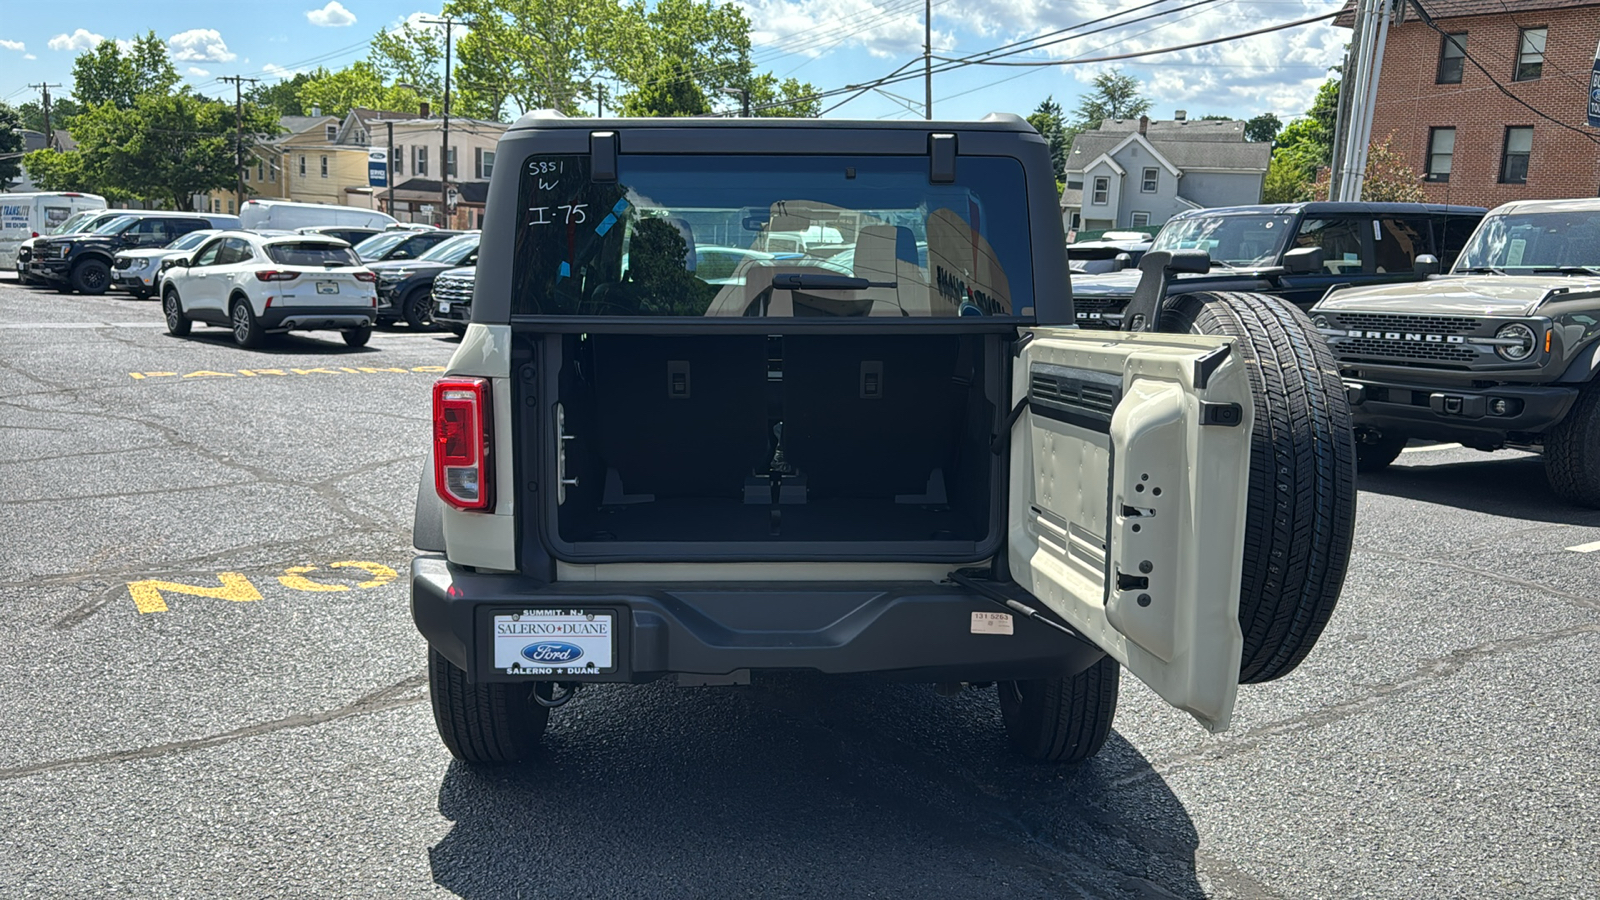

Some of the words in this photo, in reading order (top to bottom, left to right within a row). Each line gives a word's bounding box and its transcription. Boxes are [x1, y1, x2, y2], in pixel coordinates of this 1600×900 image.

[1348, 330, 1464, 344] BRONCO
[126, 560, 398, 615] NO
[497, 623, 556, 635] SALERNO
[563, 623, 608, 635] DUANE
[532, 644, 571, 660] Ford
[506, 667, 553, 675] SALERNO
[567, 667, 600, 675] DUANE
